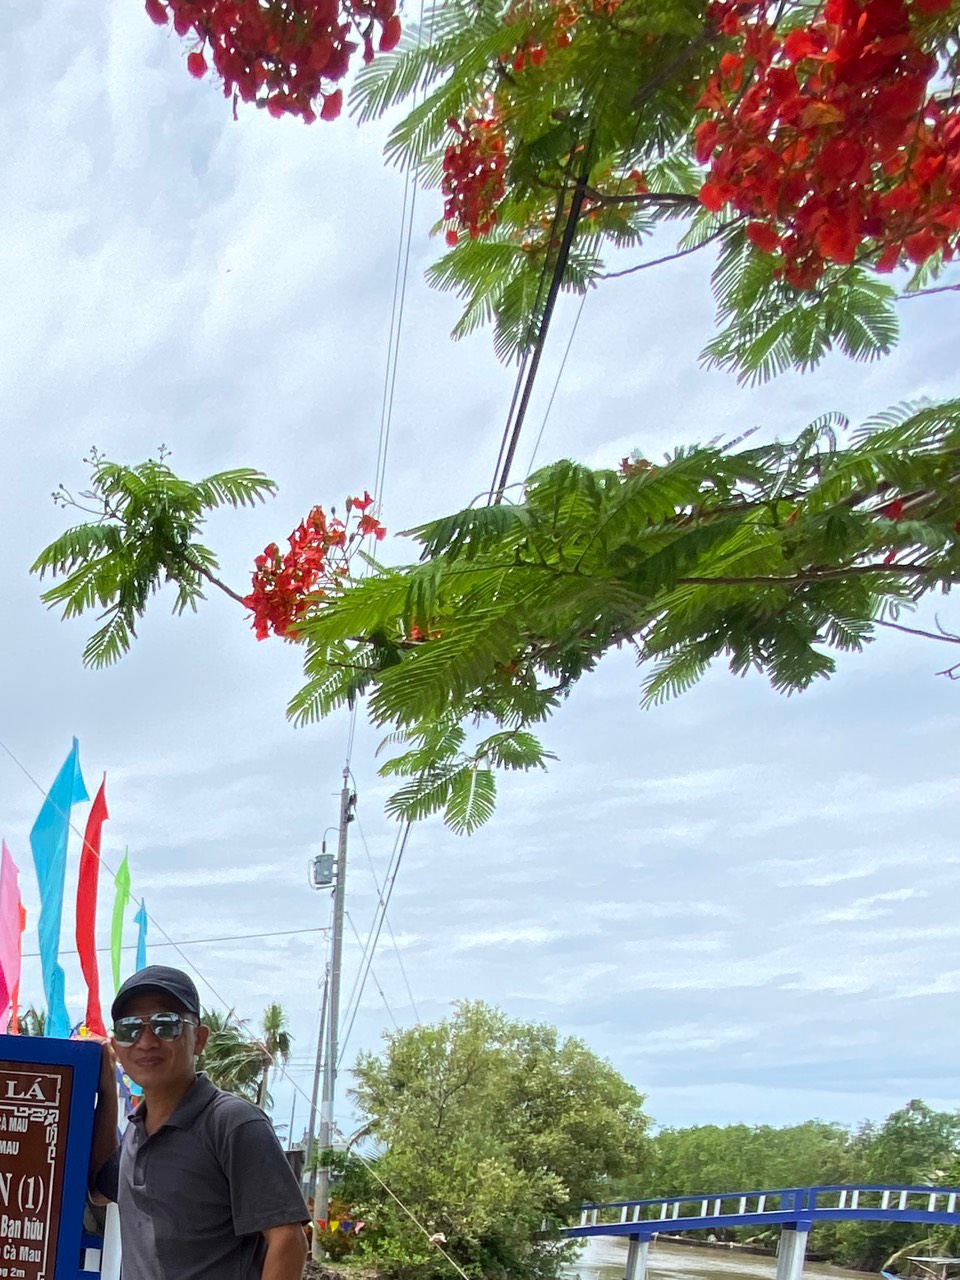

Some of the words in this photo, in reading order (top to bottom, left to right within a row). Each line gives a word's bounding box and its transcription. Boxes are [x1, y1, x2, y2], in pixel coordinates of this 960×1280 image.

[5, 1078, 46, 1100] LÁ
[8, 1117, 28, 1133] MAU
[17, 1175, 44, 1214] (1)
[0, 1214, 22, 1243] Bạn
[4, 1244, 16, 1260] Cà
[19, 1246, 42, 1262] Mau
[10, 1268, 26, 1278] 2m
